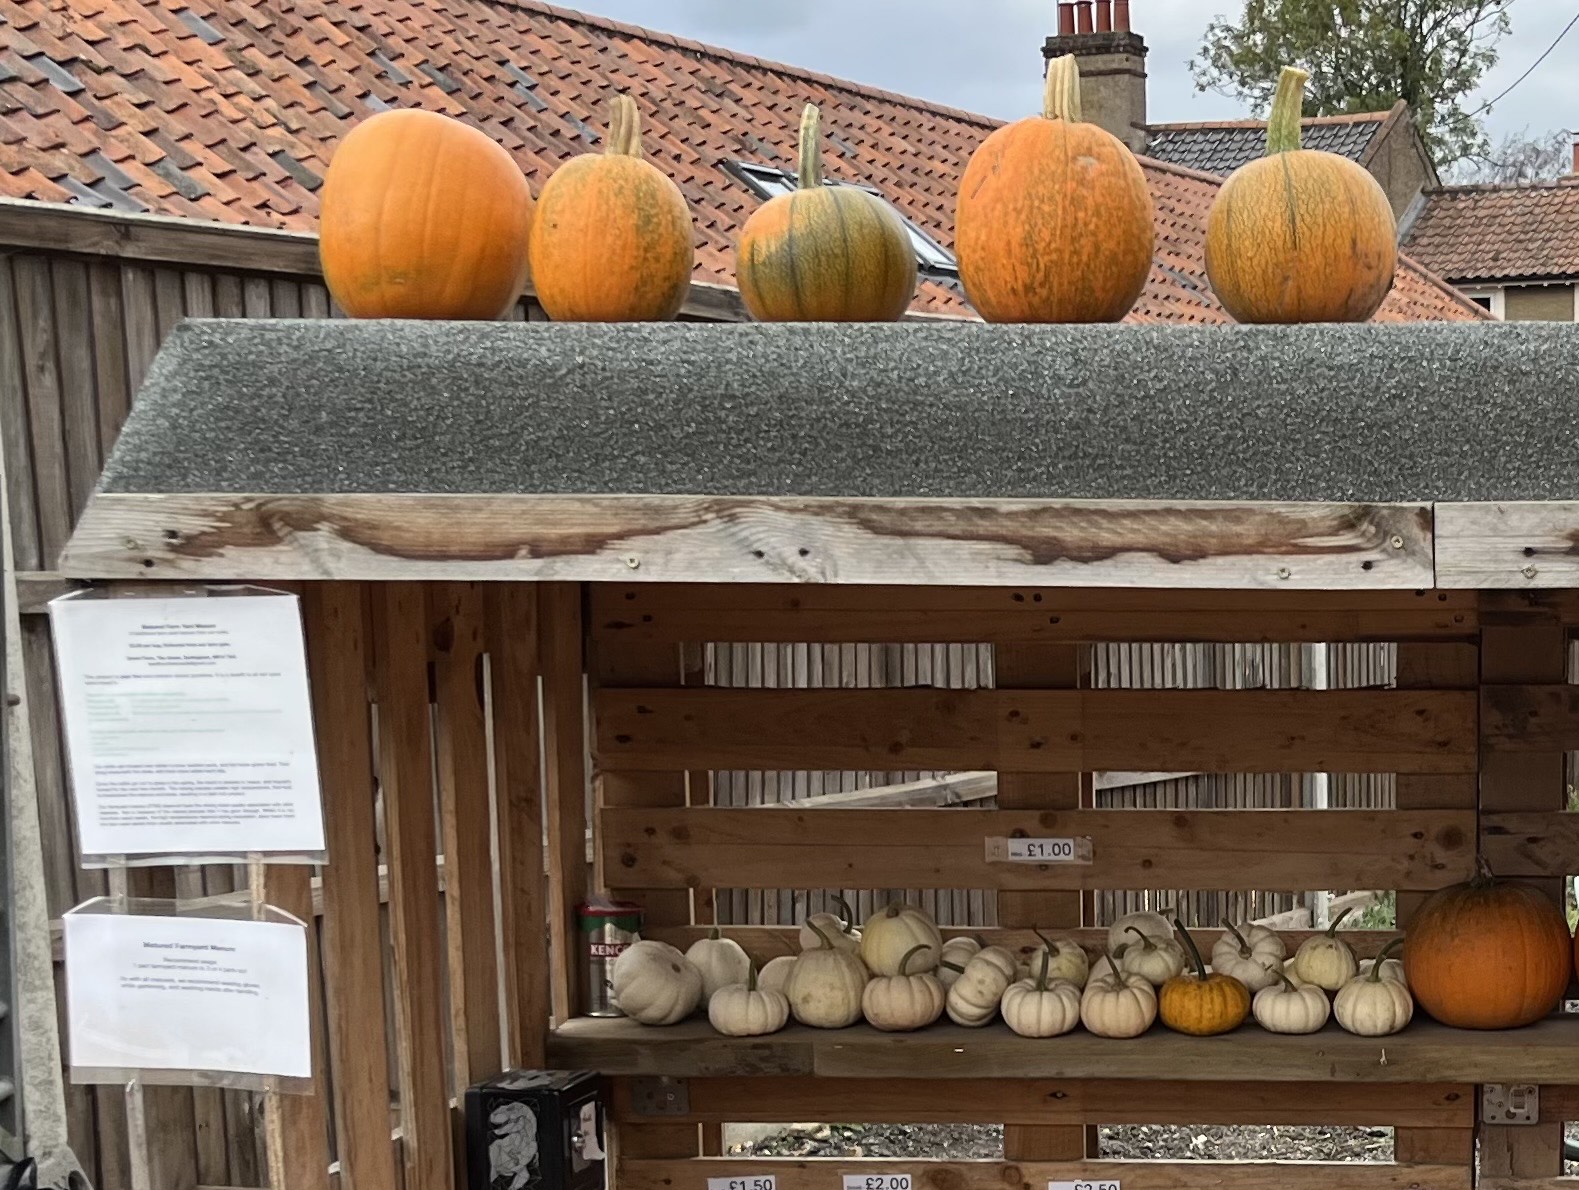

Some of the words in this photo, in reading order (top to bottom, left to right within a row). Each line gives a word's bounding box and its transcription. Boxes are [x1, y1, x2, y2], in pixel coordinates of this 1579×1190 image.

[1027, 843, 1072, 857] £1.00
[591, 944, 631, 956] KENC
[866, 1177, 909, 1190] £2.00
